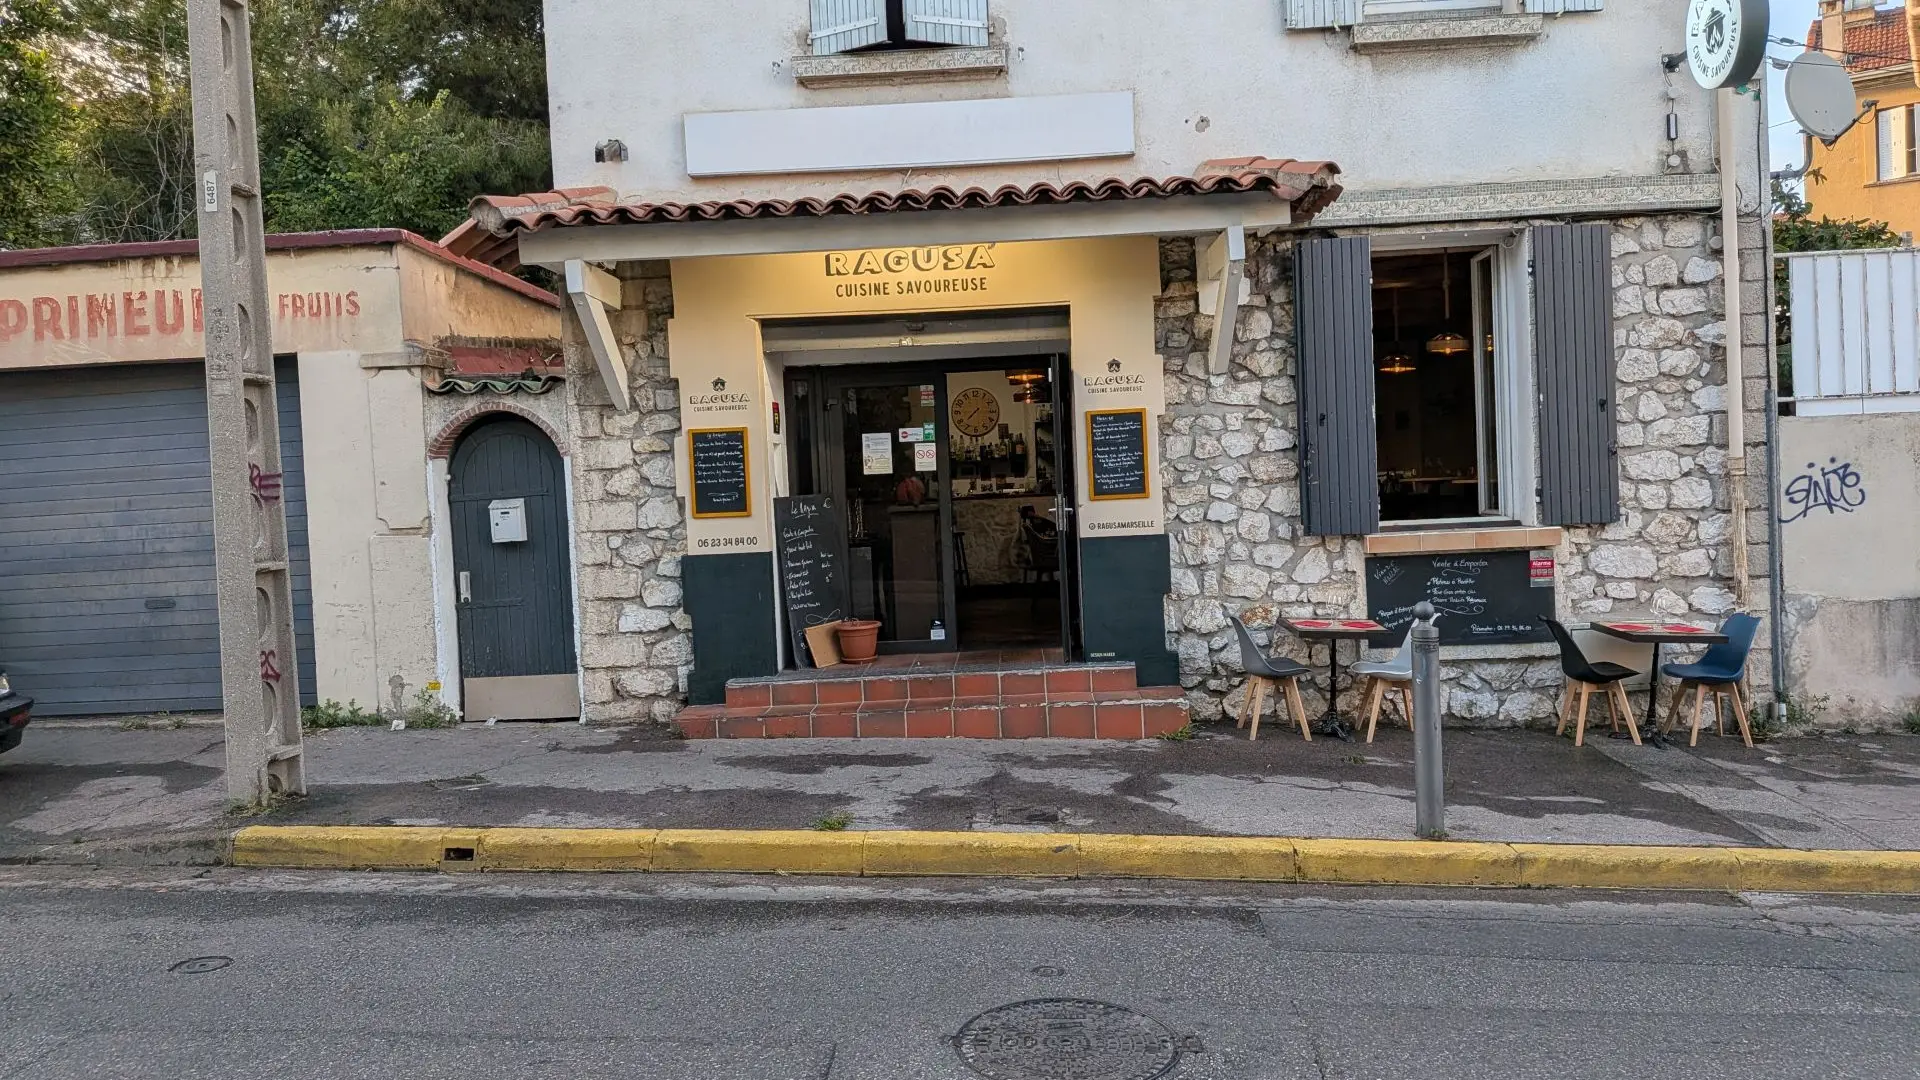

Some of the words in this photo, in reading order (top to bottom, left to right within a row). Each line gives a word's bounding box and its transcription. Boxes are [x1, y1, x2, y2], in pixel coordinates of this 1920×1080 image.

[1692, 45, 1710, 77] CUISINE
[1711, 20, 1737, 78] SAVOUREUSE
[206, 180, 216, 205] 6487
[825, 245, 996, 276] RAGUSA
[836, 281, 890, 298] CUISINE
[896, 277, 988, 295] SAVOUREUSE
[1084, 374, 1145, 387] RAGUSA
[1109, 385, 1142, 393] SAVOUREUSE
[689, 393, 750, 405] RAGUSA
[697, 538, 709, 548] 06
[710, 538, 721, 547] 23
[722, 537, 733, 546] 34
[734, 537, 745, 546] 84
[746, 536, 758, 546] 00
[1432, 557, 1451, 568] Vente
